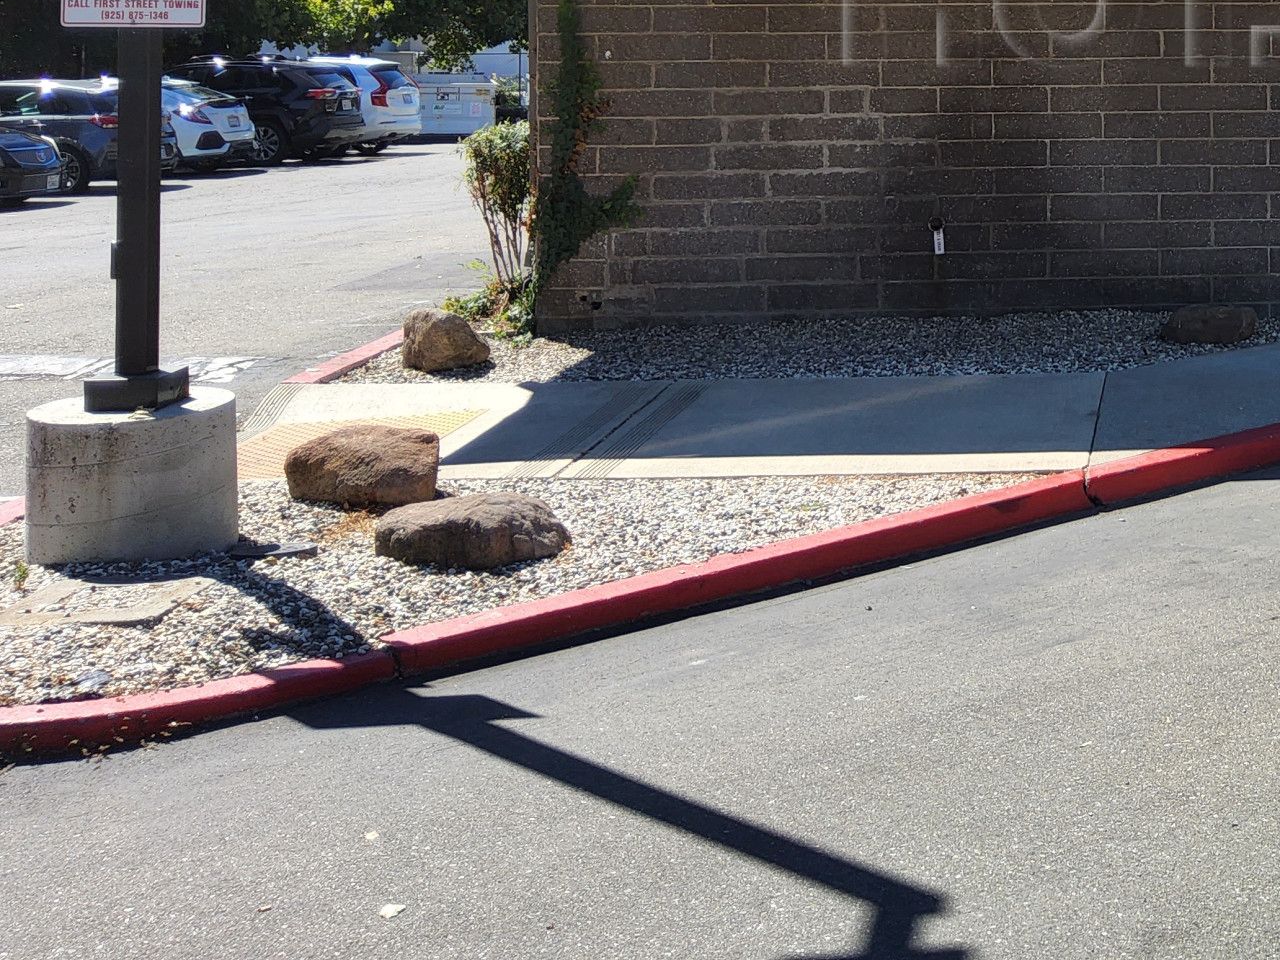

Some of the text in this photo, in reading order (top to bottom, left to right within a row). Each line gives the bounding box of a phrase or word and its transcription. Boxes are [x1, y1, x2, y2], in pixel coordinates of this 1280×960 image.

[67, 0, 199, 9] CALL FIRST STREET TOWING
[101, 10, 125, 20] (925)
